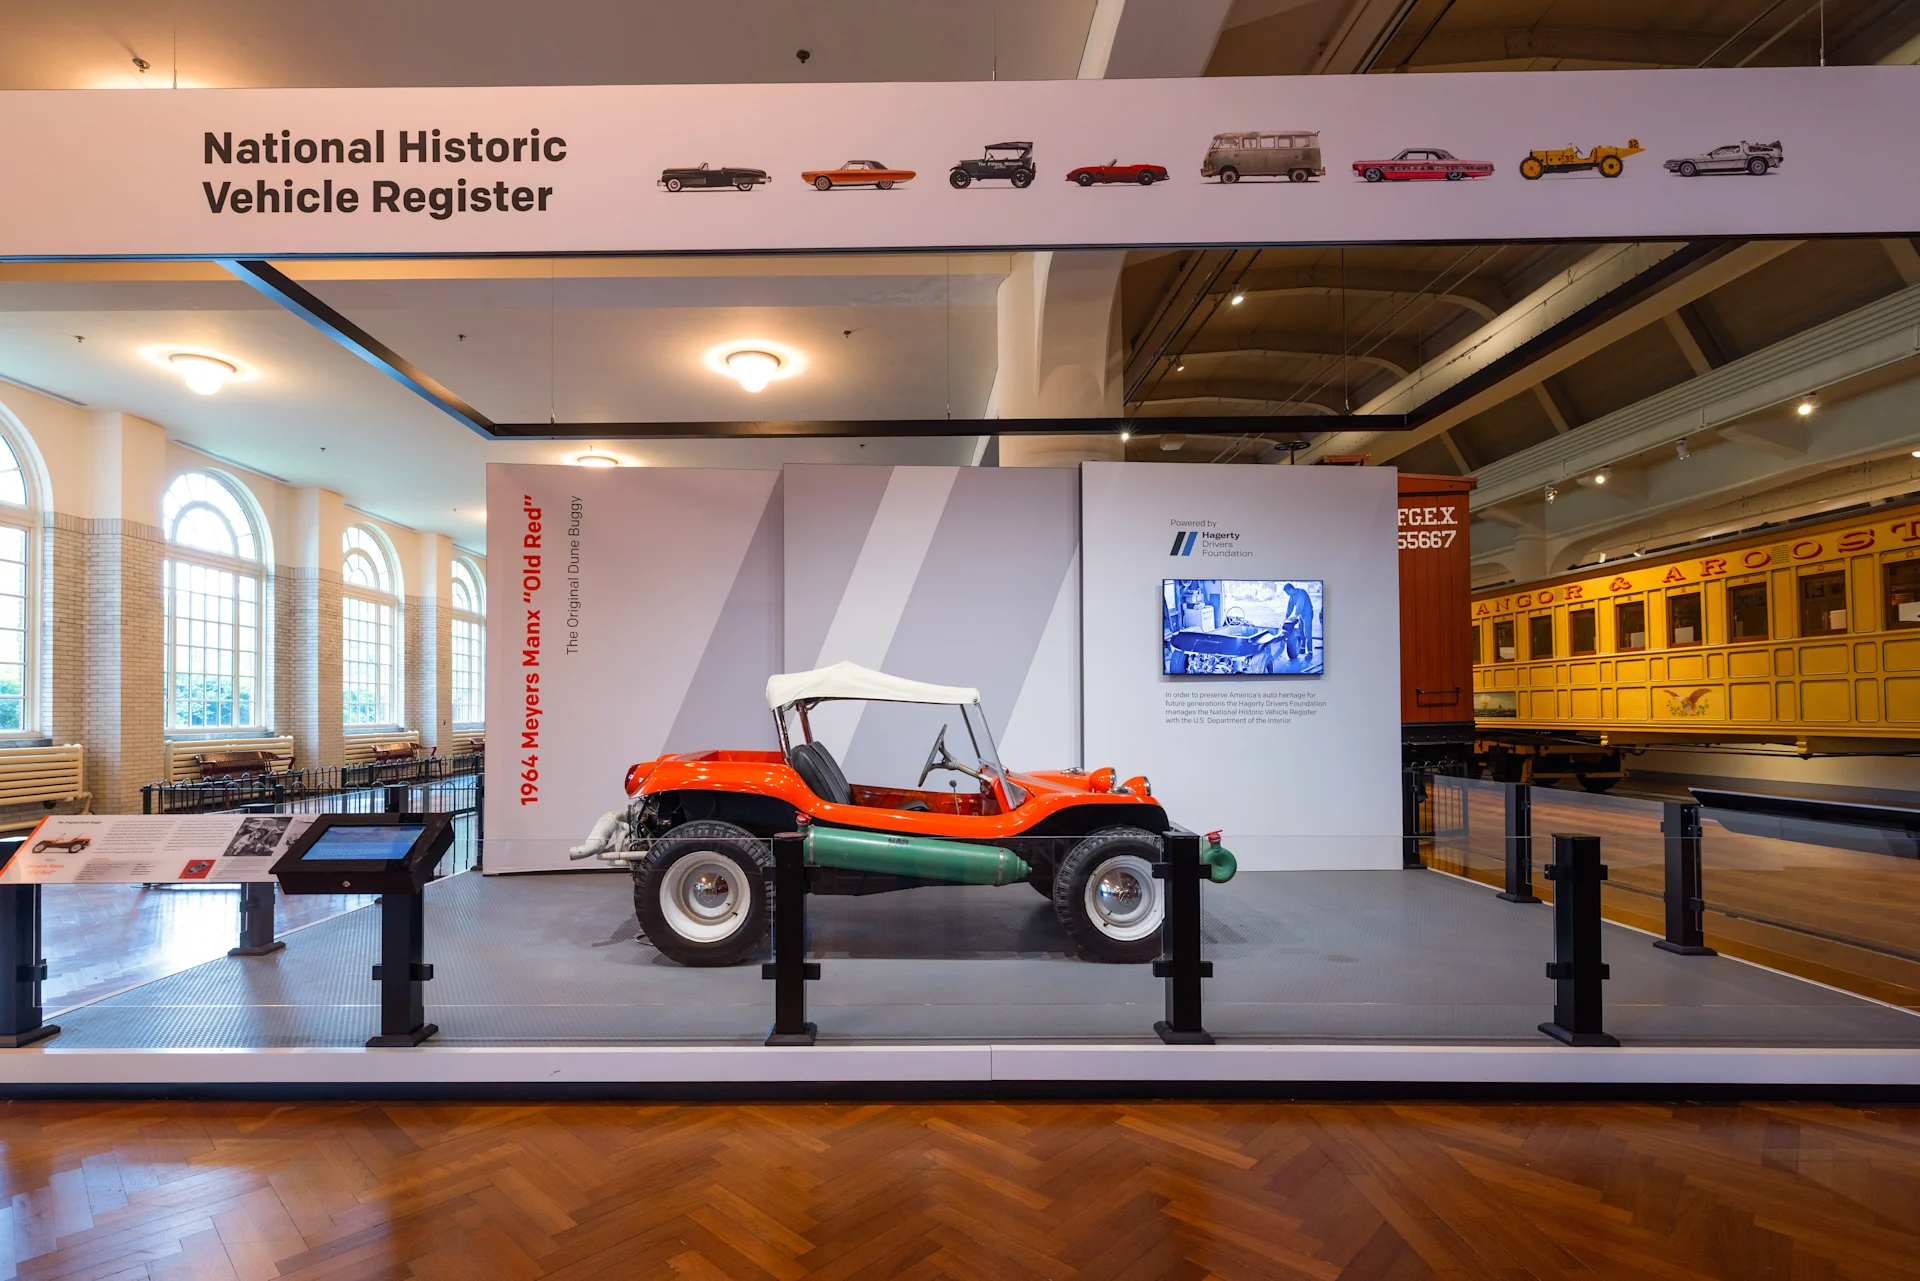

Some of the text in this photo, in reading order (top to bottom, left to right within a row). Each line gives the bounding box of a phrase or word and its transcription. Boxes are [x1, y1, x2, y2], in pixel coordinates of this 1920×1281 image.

[204, 128, 568, 164] National Historic
[1628, 140, 1638, 148] 32
[1565, 155, 1574, 163] 32
[202, 178, 553, 221] Vehicle Register
[1170, 518, 1217, 528] Powered by
[1202, 532, 1240, 540] Hagerty
[1398, 530, 1456, 550] 55667
[566, 496, 582, 655] The Original Dune Buggy
[1608, 576, 1632, 592] &
[520, 494, 542, 806] 1964 Meyers Manx "Old Red"
[1278, 692, 1306, 700] heritage
